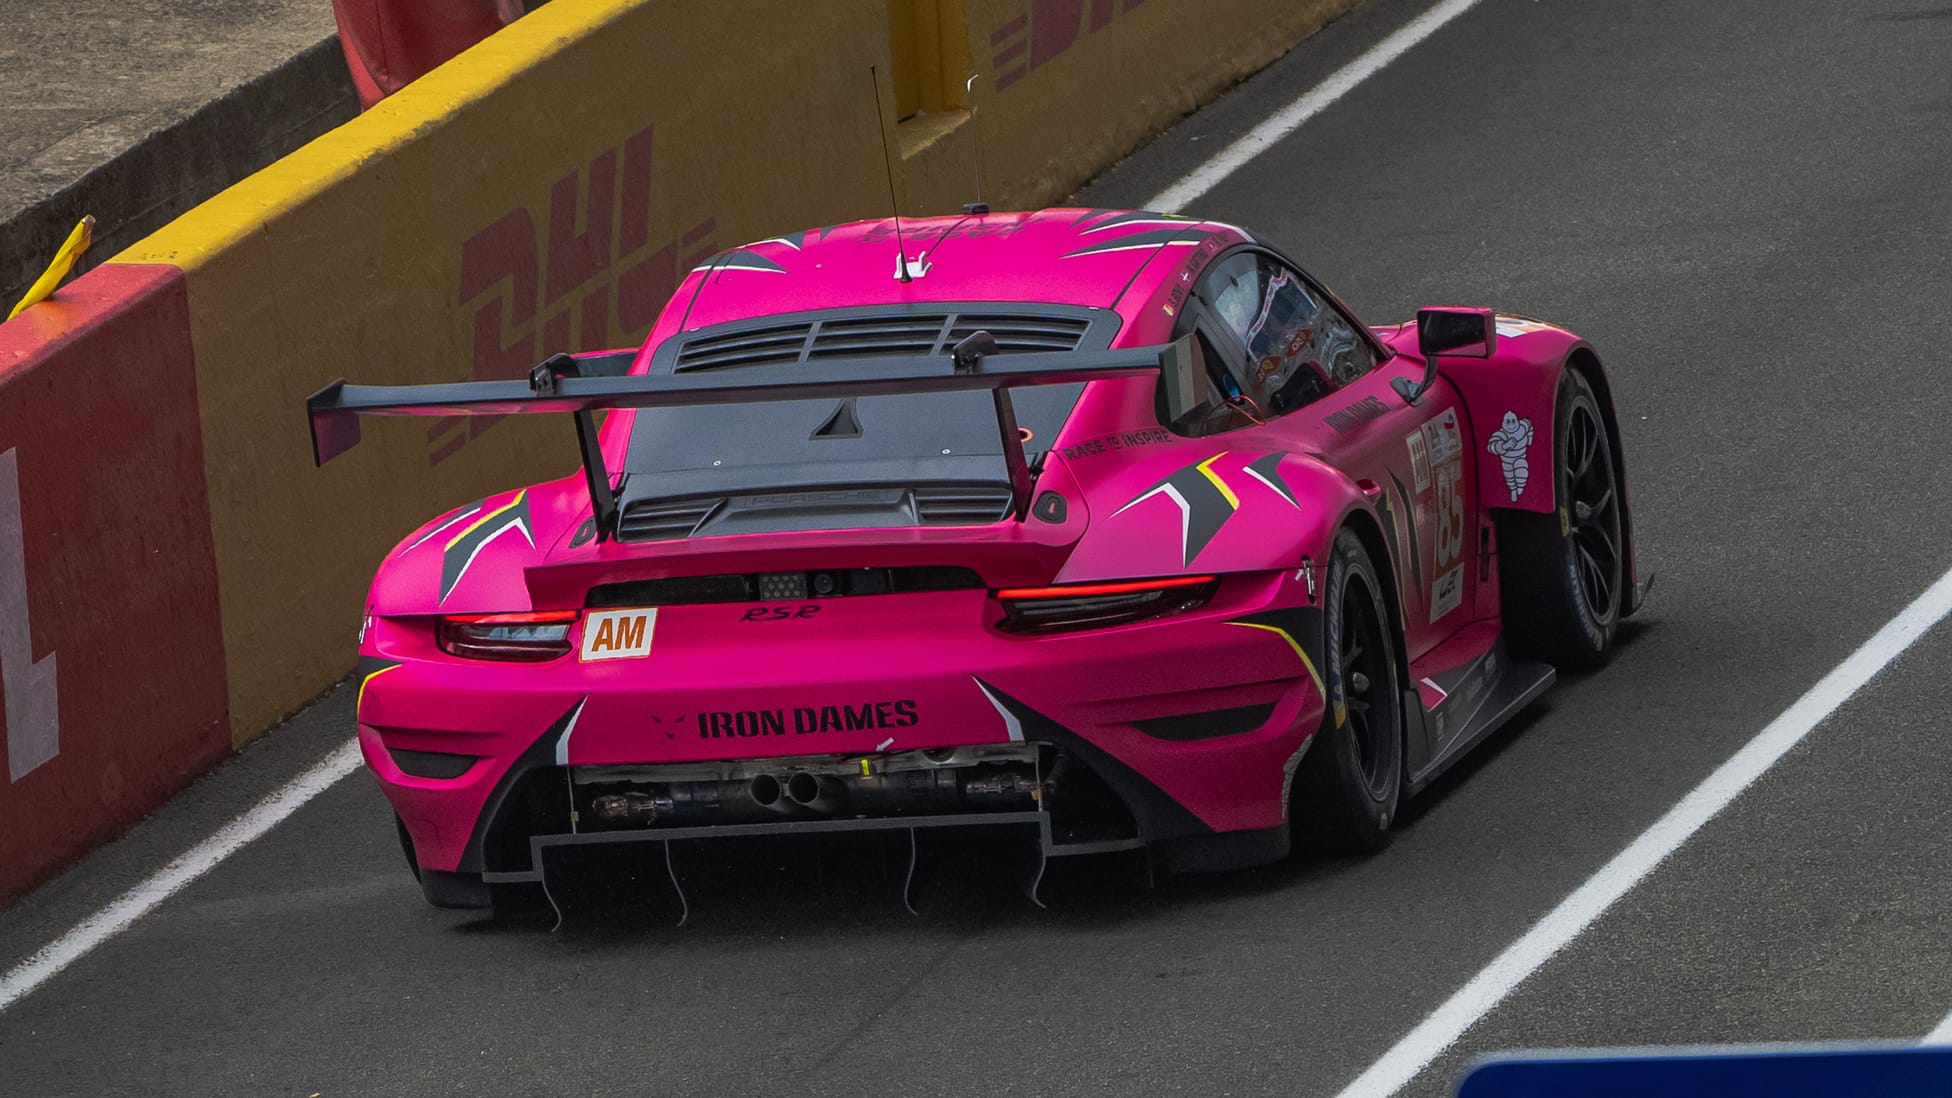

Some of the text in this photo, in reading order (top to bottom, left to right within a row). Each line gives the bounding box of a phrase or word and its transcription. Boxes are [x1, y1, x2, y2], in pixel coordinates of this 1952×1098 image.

[459, 125, 678, 440] DHL
[1062, 428, 1173, 461] RACE TO INSPIRE
[751, 490, 881, 506] PORSCHE
[1437, 460, 1464, 568] 85
[740, 604, 822, 623] RSR
[1329, 558, 1343, 673] MICHELIN
[591, 615, 648, 653] AM
[697, 699, 919, 739] IRON DAMES
